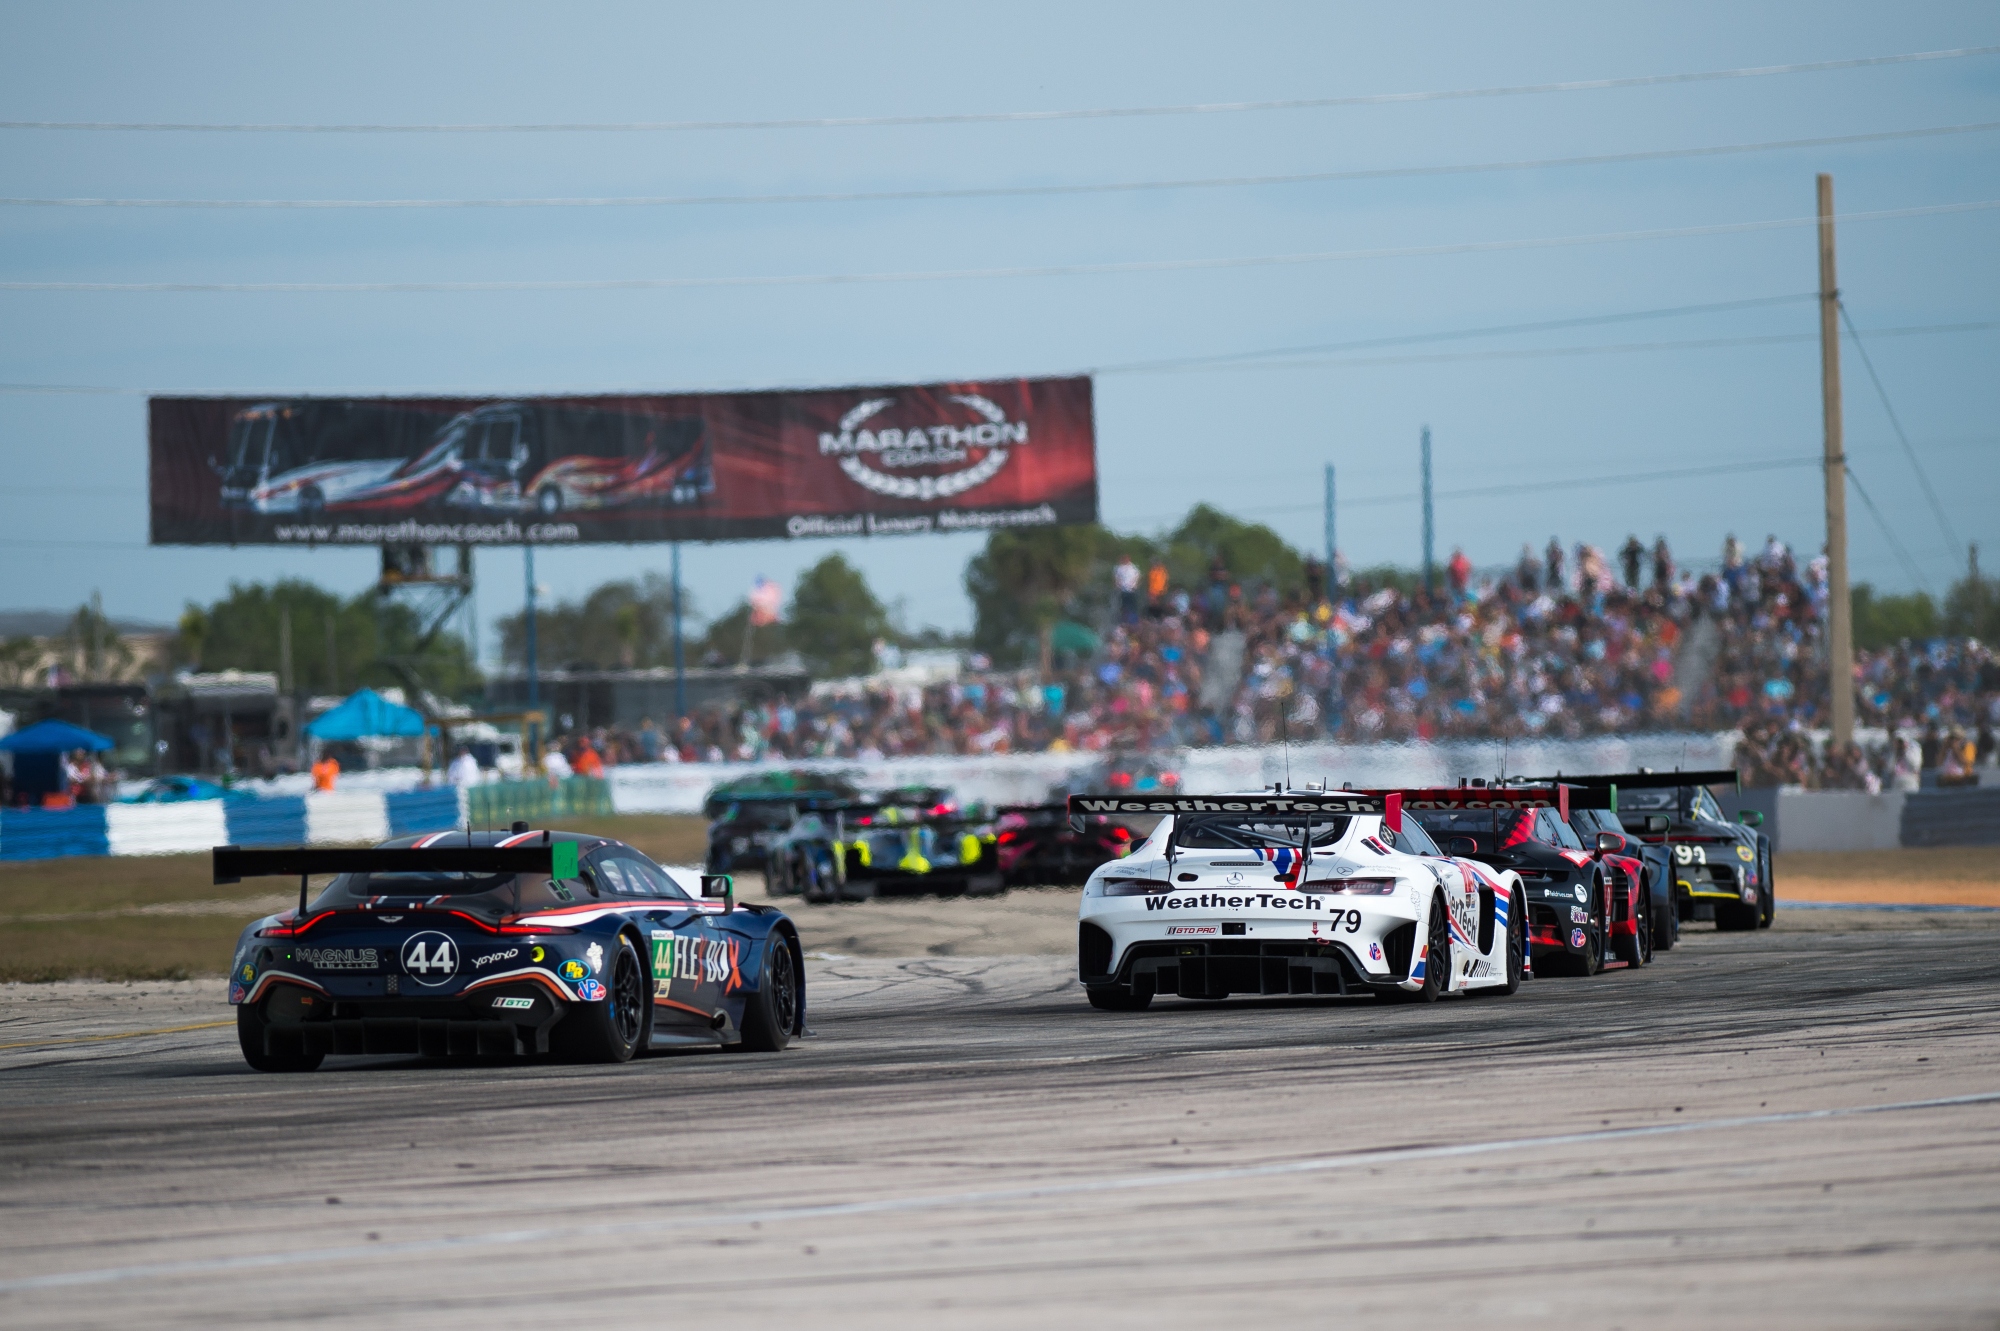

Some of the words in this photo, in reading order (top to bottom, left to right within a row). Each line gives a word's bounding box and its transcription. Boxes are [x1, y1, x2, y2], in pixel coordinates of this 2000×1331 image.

[818, 422, 1028, 453] MARATHON
[786, 514, 863, 537] Official
[867, 513, 932, 533] Luxury
[938, 503, 1056, 528] Motorcoach
[1079, 800, 1374, 813] WeatherTech
[1145, 894, 1321, 910] WeatherTech
[1329, 909, 1362, 933] 79
[296, 948, 378, 963] MAGNUS
[406, 941, 454, 973] 44
[655, 942, 671, 976] 44
